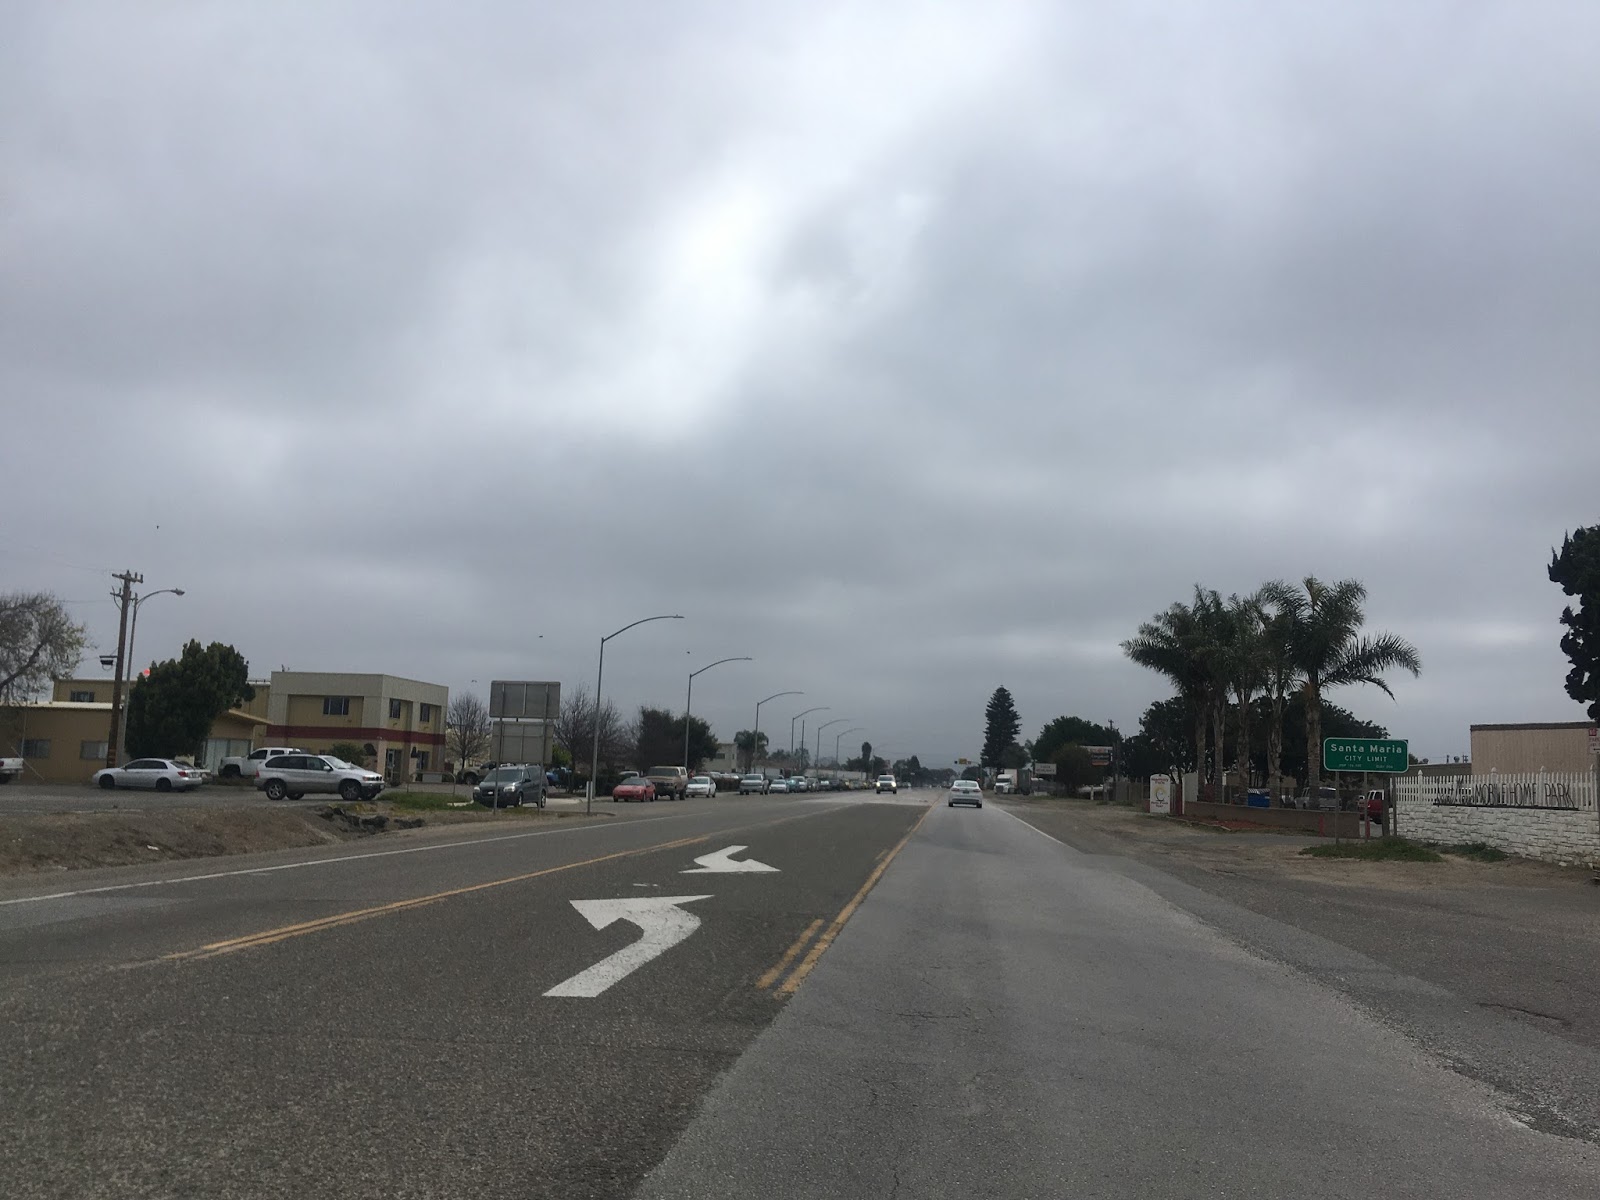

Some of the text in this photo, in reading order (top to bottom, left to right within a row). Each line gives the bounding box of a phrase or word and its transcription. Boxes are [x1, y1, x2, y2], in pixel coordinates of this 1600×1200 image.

[1330, 743, 1402, 754] Santa Maria
[1474, 783, 1507, 805] MOBILE
[1509, 782, 1537, 807] HOME
[1544, 782, 1575, 808] PARK
